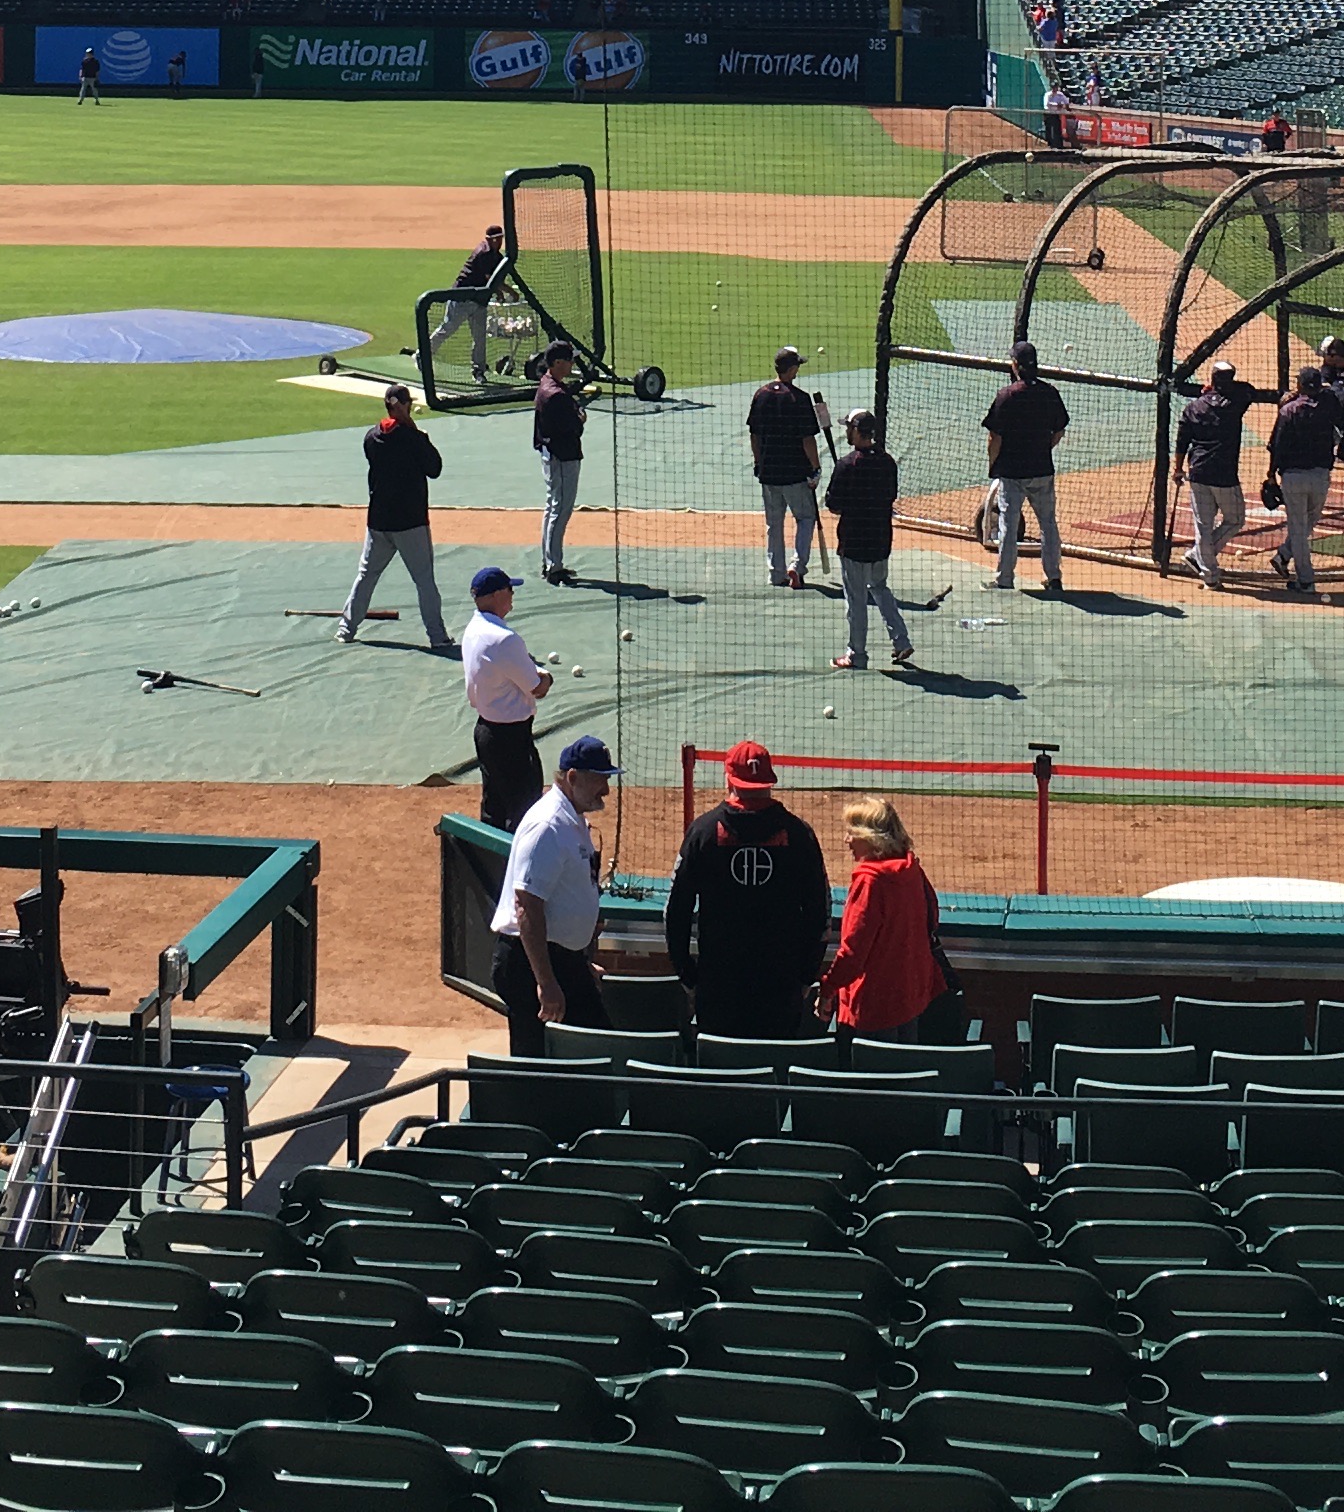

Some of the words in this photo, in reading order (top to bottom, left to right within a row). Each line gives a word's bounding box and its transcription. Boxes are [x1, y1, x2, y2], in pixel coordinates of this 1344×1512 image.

[685, 33, 708, 45] 349
[869, 38, 887, 51] 325
[294, 39, 424, 67] National
[475, 43, 544, 78] Gulf
[718, 47, 860, 82] NITTOTIRE.COM
[340, 69, 369, 82] Car
[371, 69, 421, 82] Rental
[747, 758, 761, 776] T
